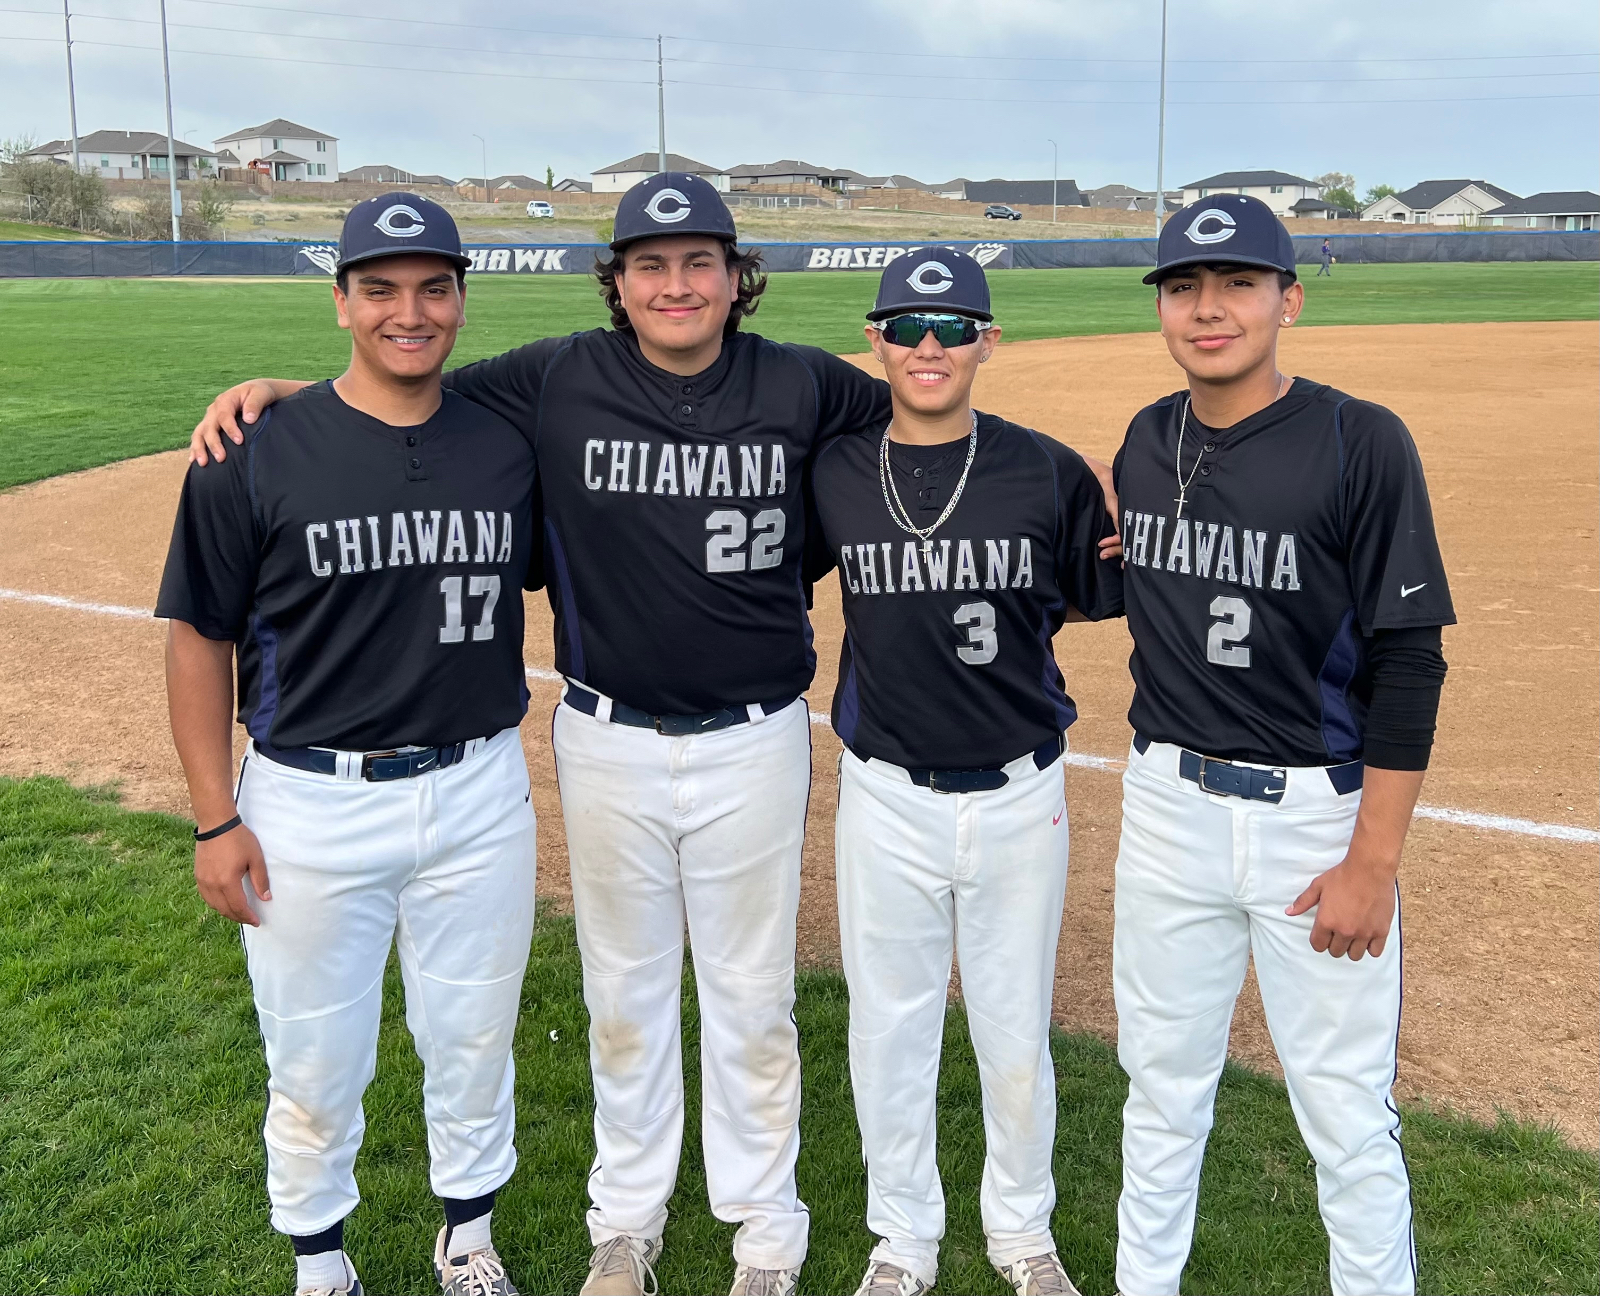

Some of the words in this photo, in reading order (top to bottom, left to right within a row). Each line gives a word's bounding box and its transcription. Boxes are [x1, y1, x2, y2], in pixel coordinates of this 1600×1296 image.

[373, 204, 426, 238] C
[643, 188, 692, 224] C
[1183, 208, 1237, 245] C
[807, 247, 956, 269] BASEB
[905, 260, 954, 294] C
[583, 438, 787, 498] CHIAWANA
[305, 510, 514, 578] CHIAWANA
[704, 507, 787, 574] 22
[840, 537, 1034, 596] CHIAWANA
[1122, 508, 1303, 592] CHIAWANA
[438, 574, 502, 645] 17
[952, 600, 999, 666] 3
[1206, 594, 1252, 669] 2
